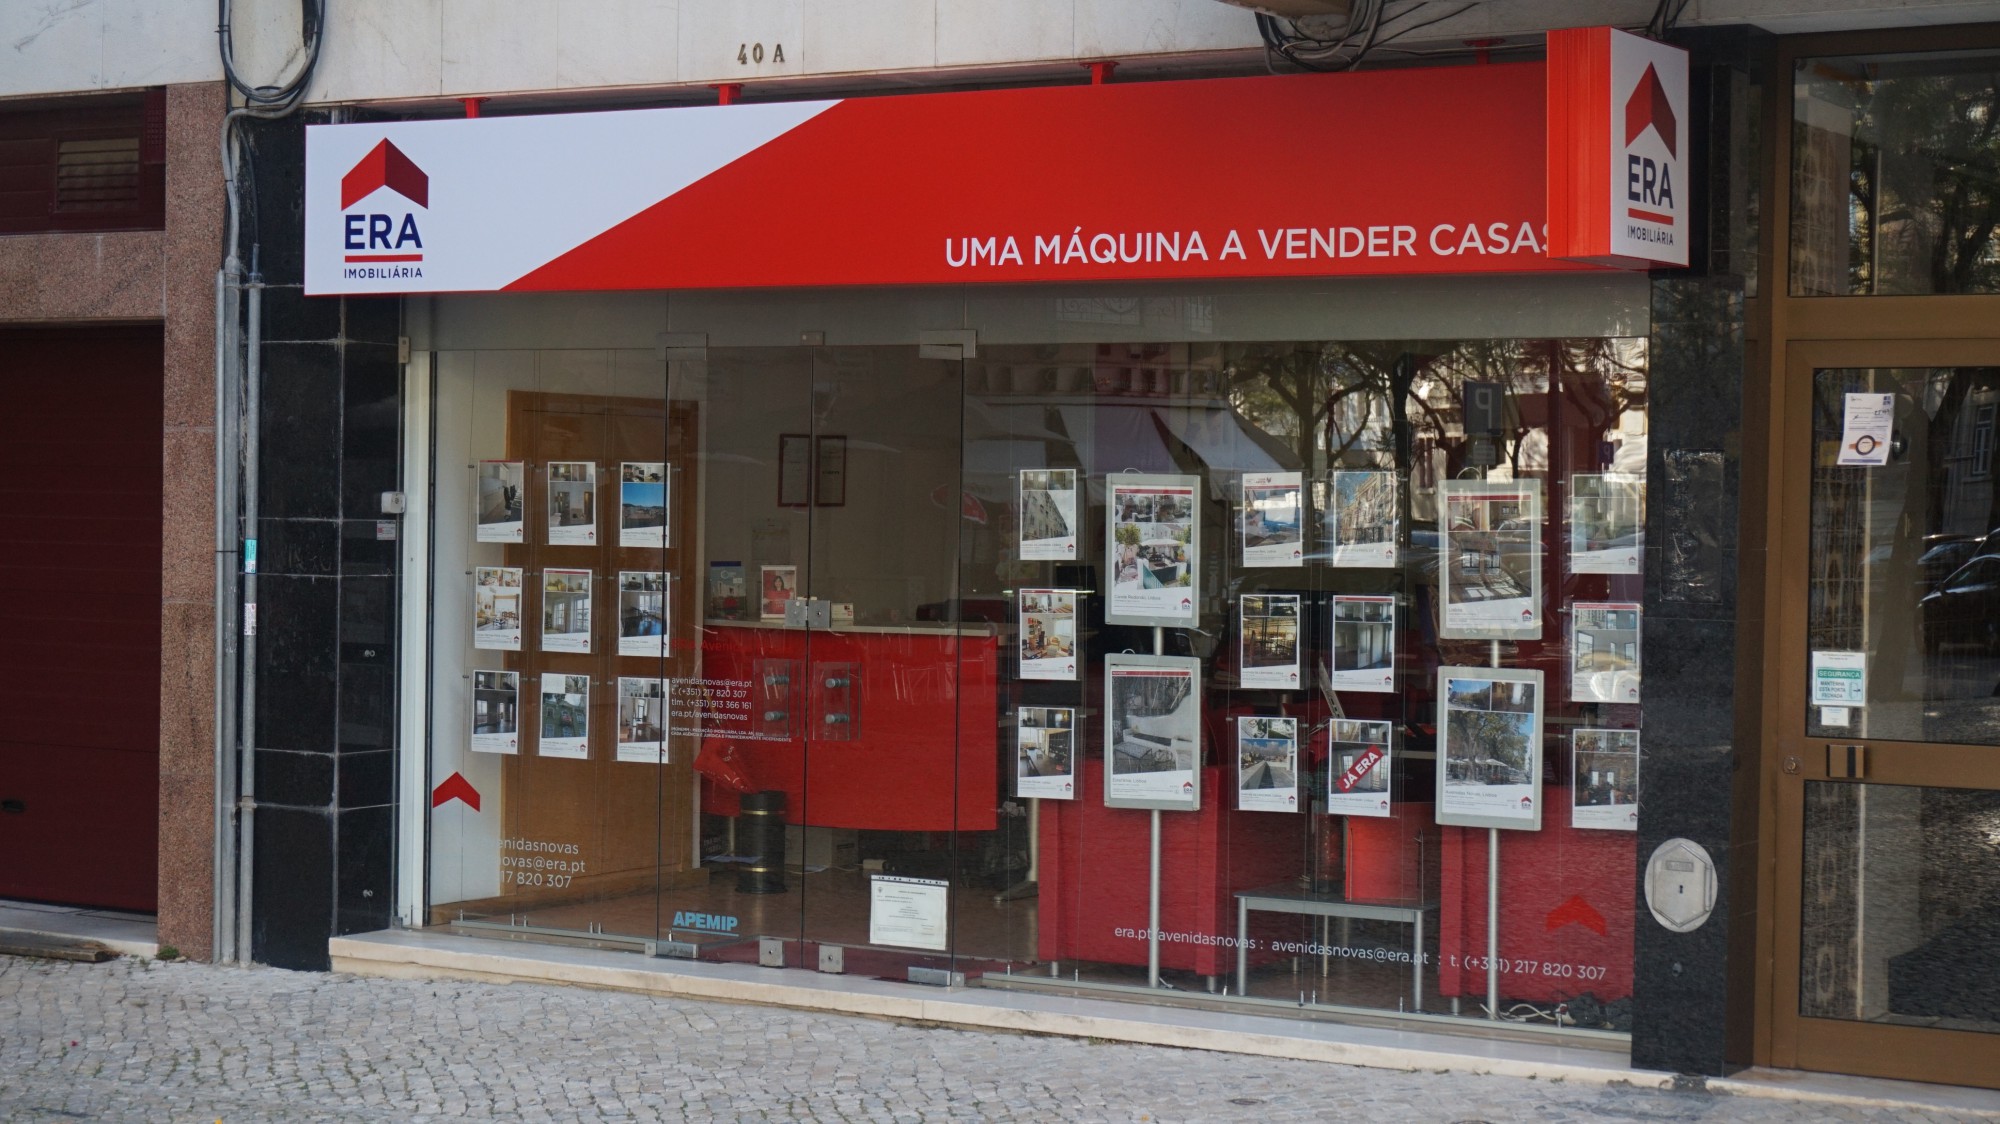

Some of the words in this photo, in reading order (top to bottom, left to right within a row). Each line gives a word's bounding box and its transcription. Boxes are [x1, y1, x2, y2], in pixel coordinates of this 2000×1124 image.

[737, 42, 764, 65] 40
[772, 43, 786, 63] A
[1628, 153, 1674, 209] ERA
[345, 213, 423, 250] ERA
[1628, 225, 1674, 246] IMOBILIÁRIA
[946, 235, 1023, 268] UMA
[1034, 226, 1209, 265] MÁQUINA
[1219, 229, 1247, 261] A
[1257, 225, 1417, 260] VENDER
[1429, 221, 1548, 256] CASA
[344, 265, 423, 279] IMOBILIÁRIA
[671, 677, 753, 688] avenidasnovas@era.pt
[1818, 670, 1860, 679] SEGURANÇA
[679, 688, 701, 697] (+351)
[703, 688, 714, 697] 217
[716, 689, 730, 698] 820
[733, 690, 747, 699] 307
[687, 699, 710, 708] (+351)
[711, 699, 723, 708] 913
[726, 700, 739, 709] 366
[742, 701, 752, 710] 161
[671, 709, 748, 721] era.pt/avenidasnovas
[1344, 771, 1358, 789] JÁ
[1355, 752, 1379, 775] ERA
[517, 871, 543, 887] 820
[546, 873, 572, 888] 307
[673, 911, 739, 931] APEMIP
[1271, 938, 1429, 965] avenidasnovas@era.pt
[1450, 955, 1460, 968] t.
[1514, 959, 1538, 974] 217
[1543, 962, 1572, 978] 820
[1577, 965, 1607, 981] 307
